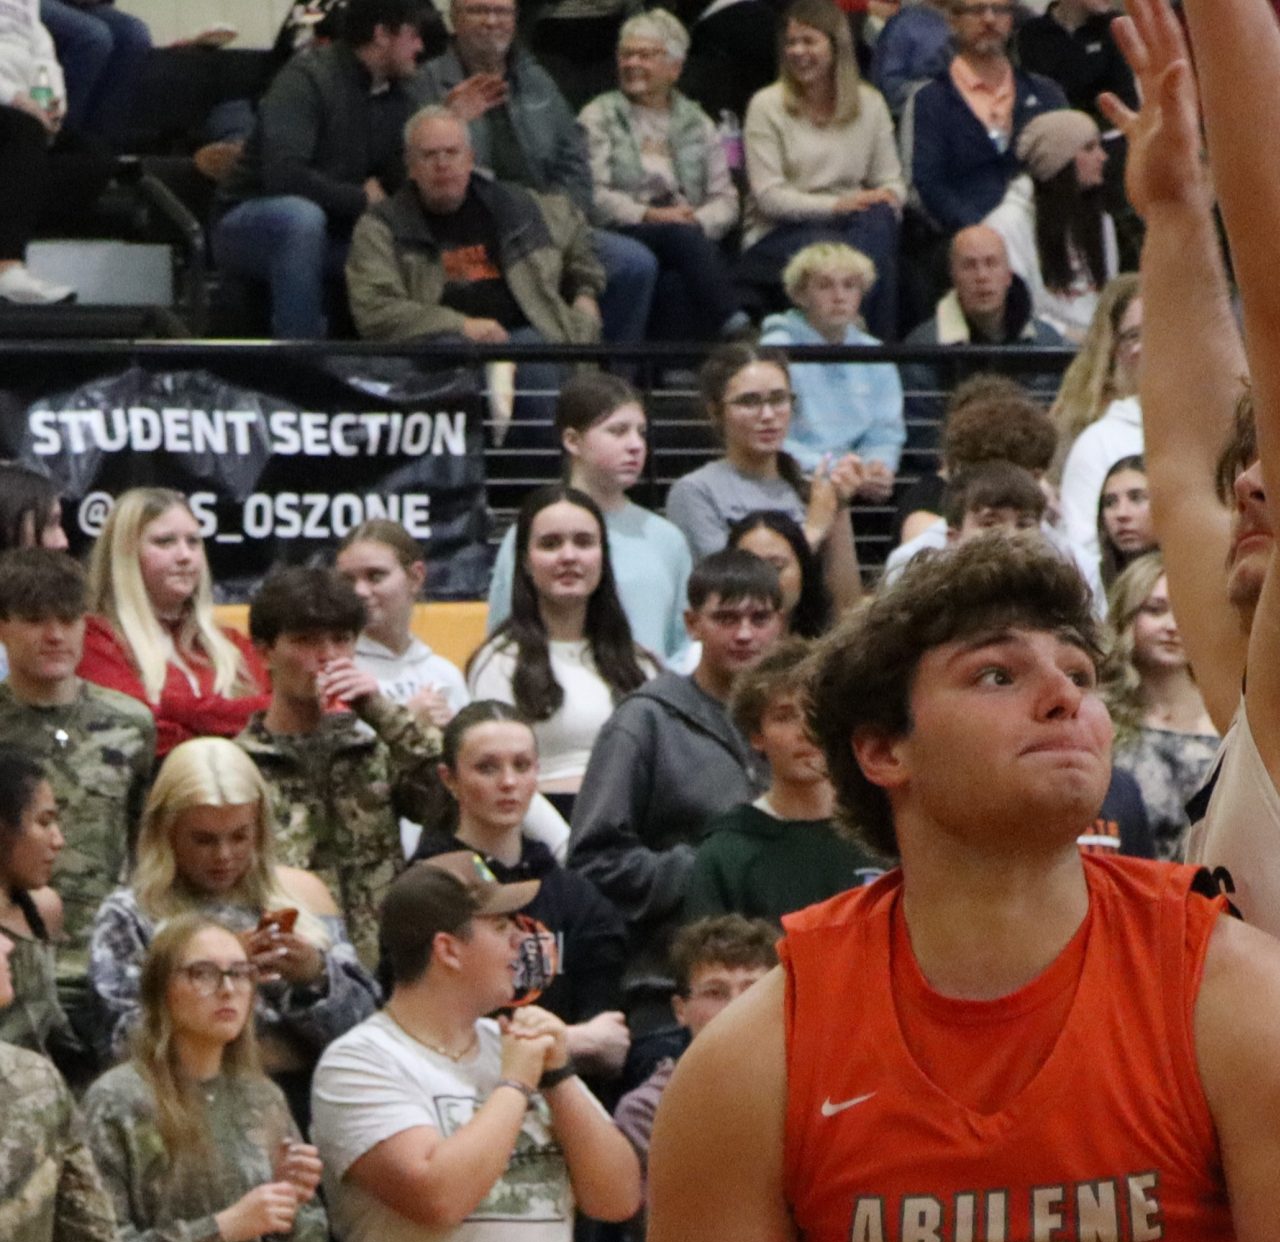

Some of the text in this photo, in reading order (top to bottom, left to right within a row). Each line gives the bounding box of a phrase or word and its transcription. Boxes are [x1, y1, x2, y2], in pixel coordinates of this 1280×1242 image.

[28, 407, 467, 457] STUDENT SECTION
[77, 490, 432, 543] @S_OSZONE
